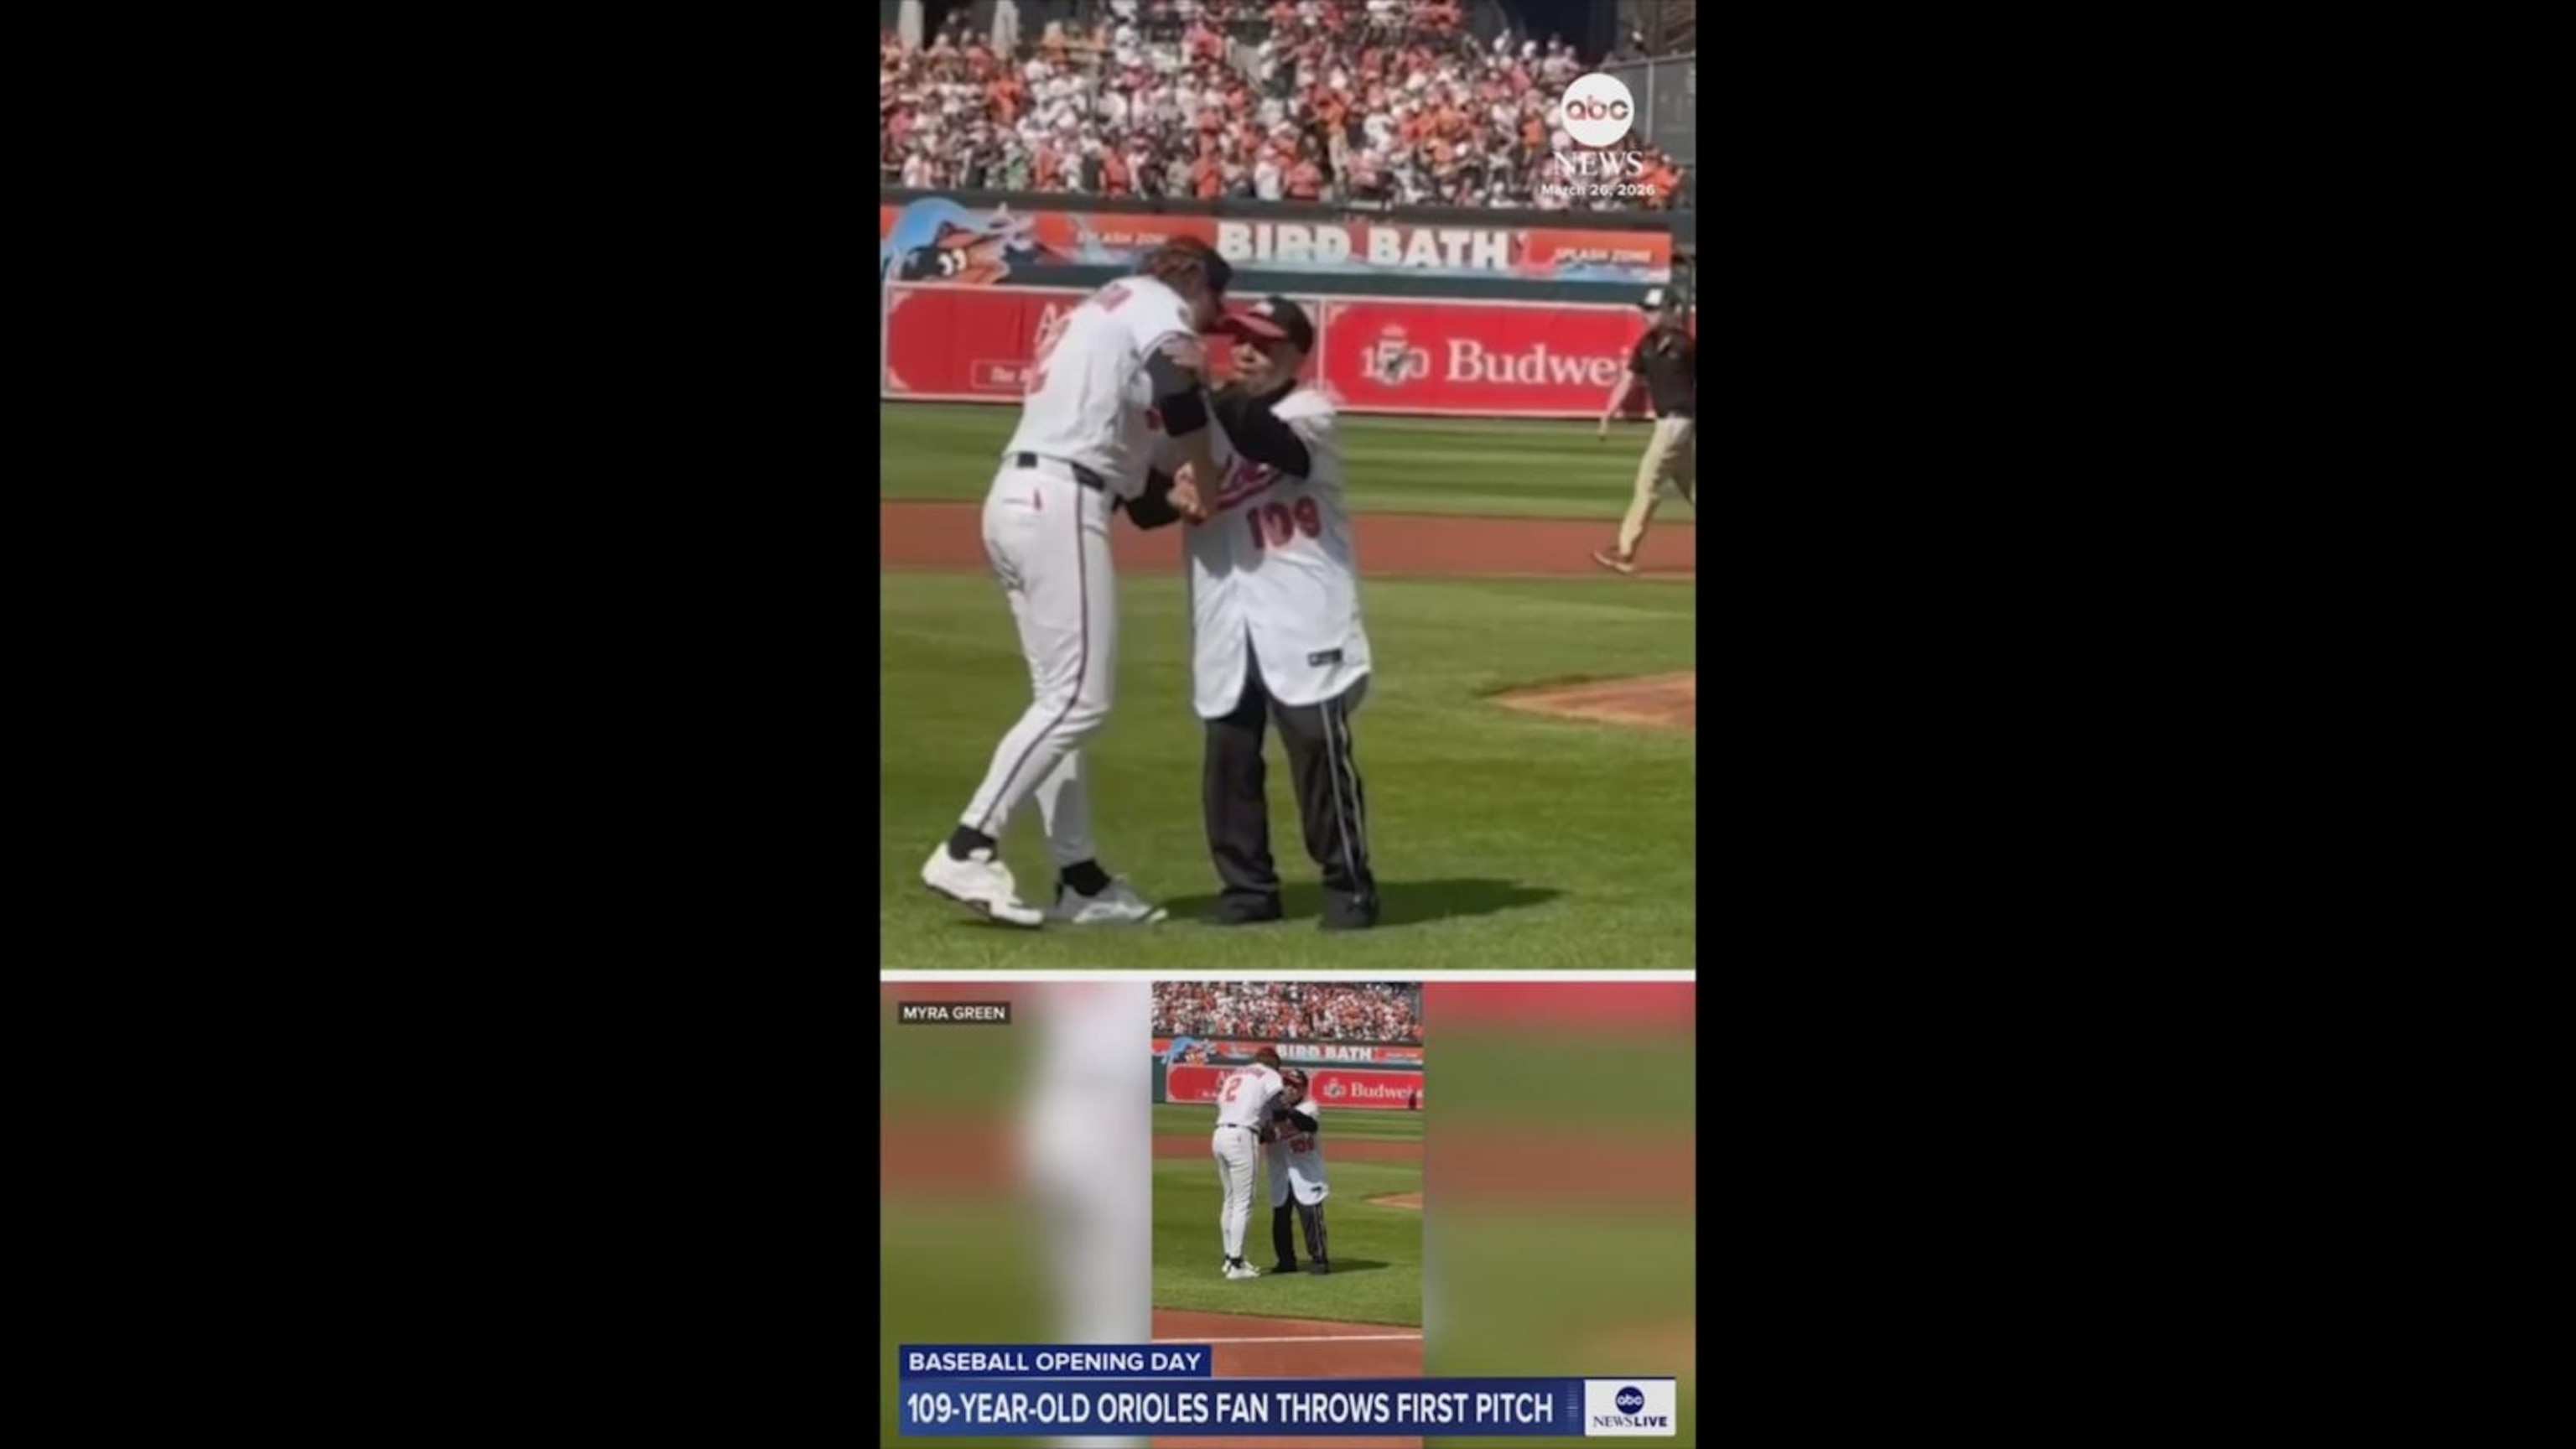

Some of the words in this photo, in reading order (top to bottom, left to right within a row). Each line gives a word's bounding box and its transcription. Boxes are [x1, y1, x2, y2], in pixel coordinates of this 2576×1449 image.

[1217, 221, 1353, 262] BIRD
[1367, 226, 1509, 269] BATH
[1445, 337, 1631, 386] Budwei
[1246, 496, 1321, 549] 109
[1325, 1046, 1372, 1060] BATH
[1224, 1077, 1243, 1103] 2
